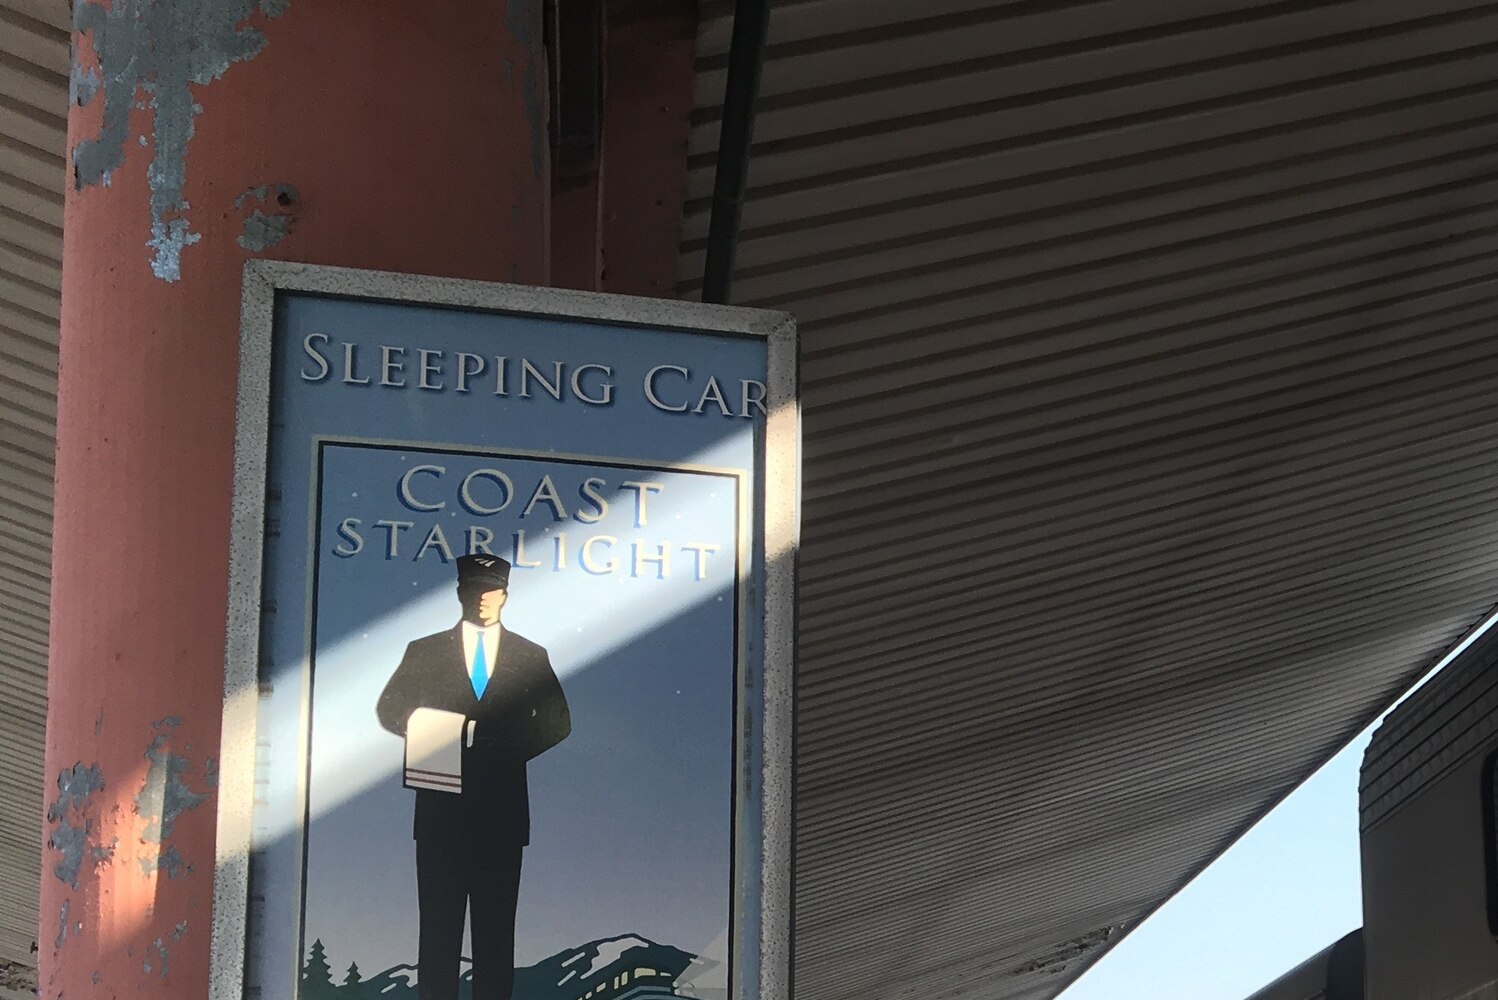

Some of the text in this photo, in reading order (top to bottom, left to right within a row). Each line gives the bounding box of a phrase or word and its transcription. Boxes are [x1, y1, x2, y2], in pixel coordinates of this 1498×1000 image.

[300, 333, 768, 419] SLEEPING CAR
[399, 464, 666, 529] COAST
[331, 517, 722, 581] STARLIGHT
